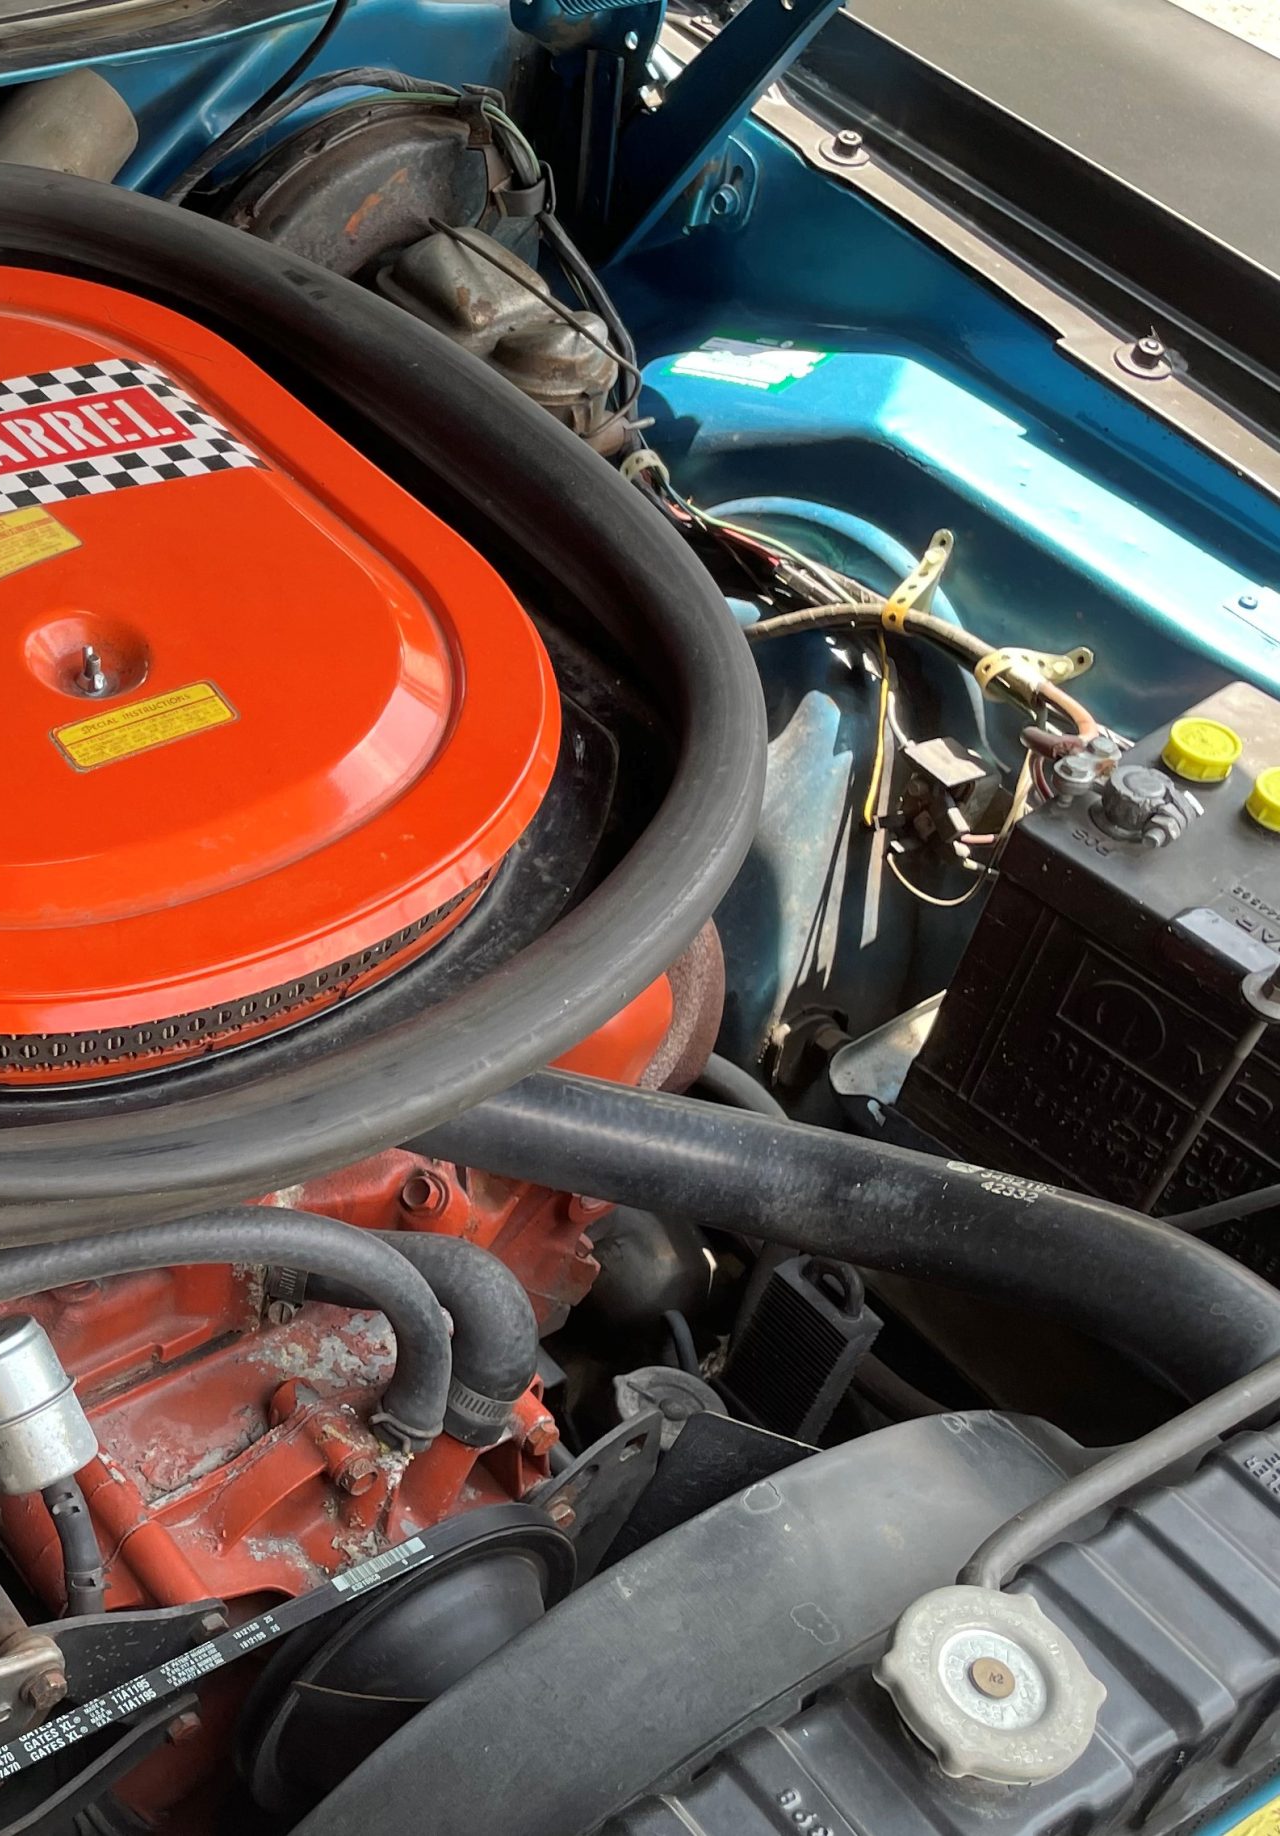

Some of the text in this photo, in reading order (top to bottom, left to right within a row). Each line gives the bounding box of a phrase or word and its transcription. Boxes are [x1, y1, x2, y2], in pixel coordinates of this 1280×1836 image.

[81, 694, 191, 735] SPECIAL INSTRUCTIONS
[980, 1181, 1039, 1203] 42332
[111, 1678, 150, 1704] 11A1195
[117, 1688, 157, 1714] 11A1195
[23, 1728, 59, 1752] GATES
[30, 1738, 66, 1762] GATES
